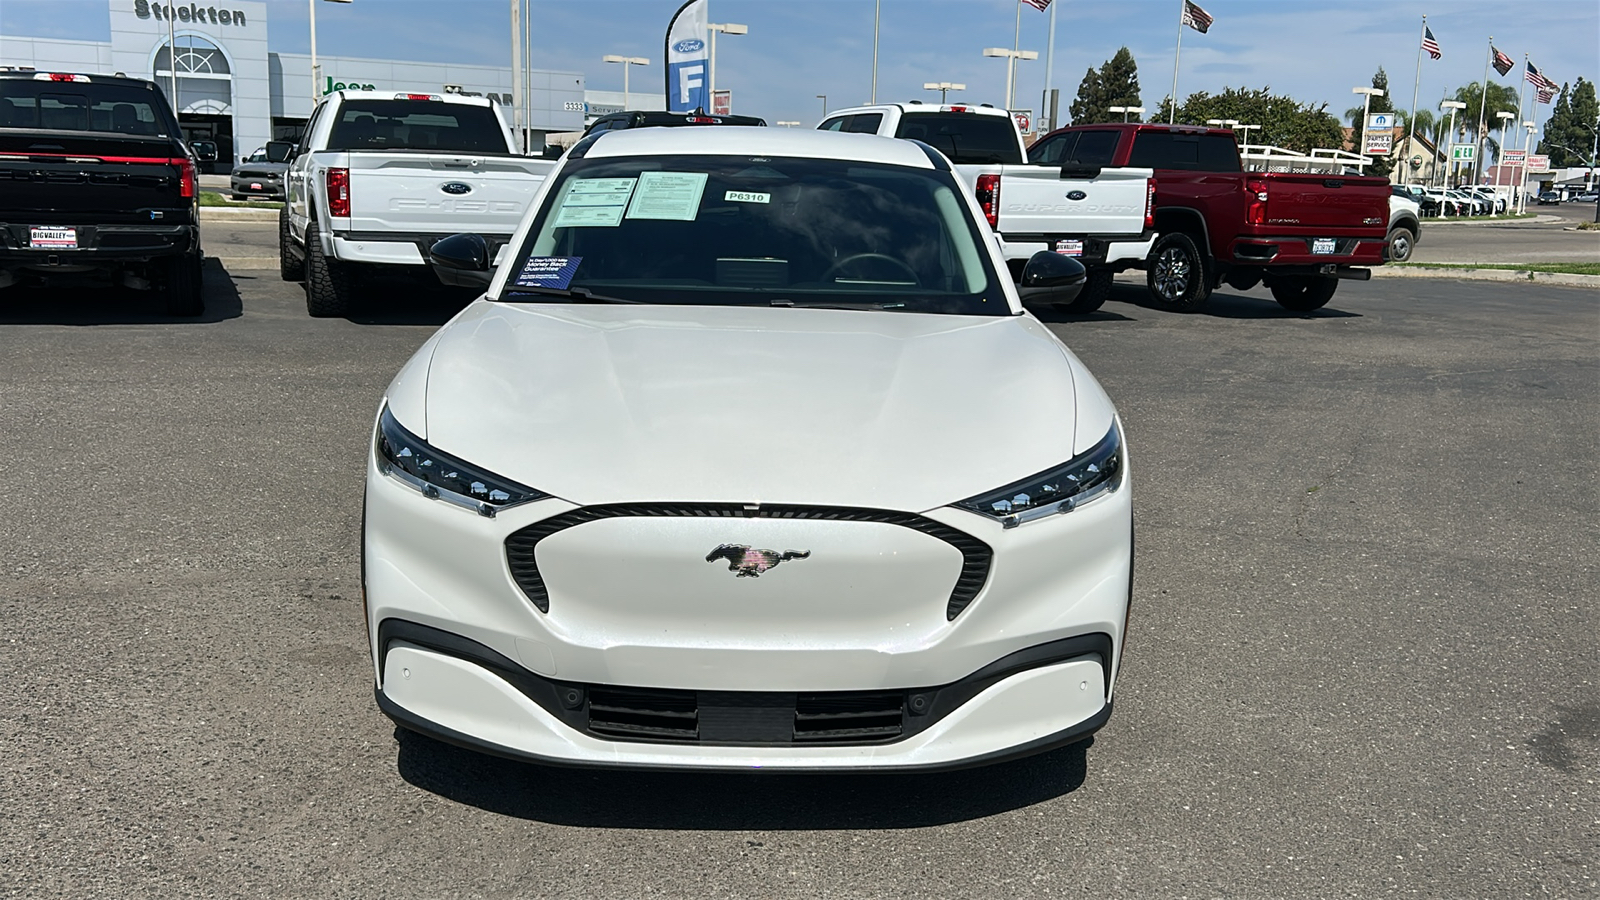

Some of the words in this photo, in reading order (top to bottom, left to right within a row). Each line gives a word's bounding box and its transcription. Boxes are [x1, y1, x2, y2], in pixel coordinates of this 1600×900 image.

[134, 0, 246, 26] Stockton
[678, 41, 700, 51] Ford
[679, 65, 703, 103] F
[565, 102, 583, 110] 3333
[1463, 147, 1473, 157] EV
[729, 193, 764, 201] P6310
[389, 198, 522, 213] F-150
[1008, 203, 1080, 212] SUPER
[1086, 204, 1138, 212] DUTY
